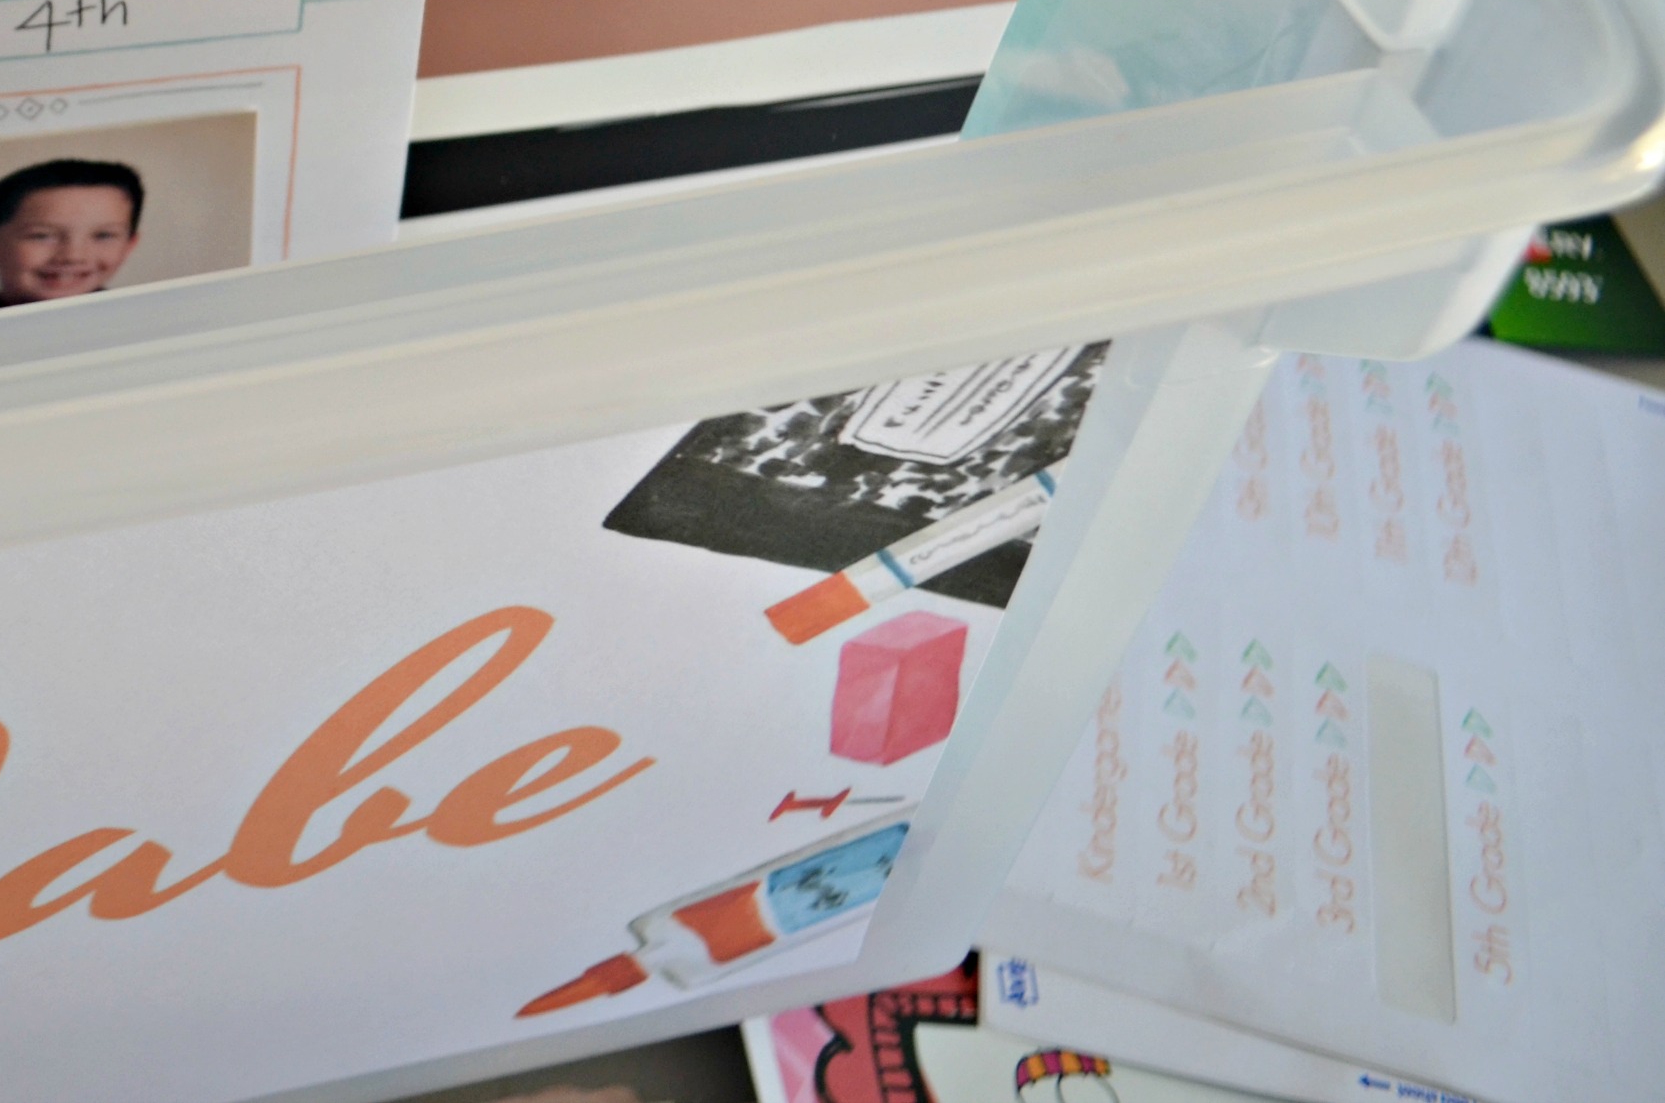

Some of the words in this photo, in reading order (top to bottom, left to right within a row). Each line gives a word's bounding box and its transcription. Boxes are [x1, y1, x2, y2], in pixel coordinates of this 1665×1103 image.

[1156, 730, 1197, 844] Grade
[1235, 730, 1276, 843] Grade
[1312, 752, 1354, 867] Grade
[1463, 802, 1510, 916] Grade
